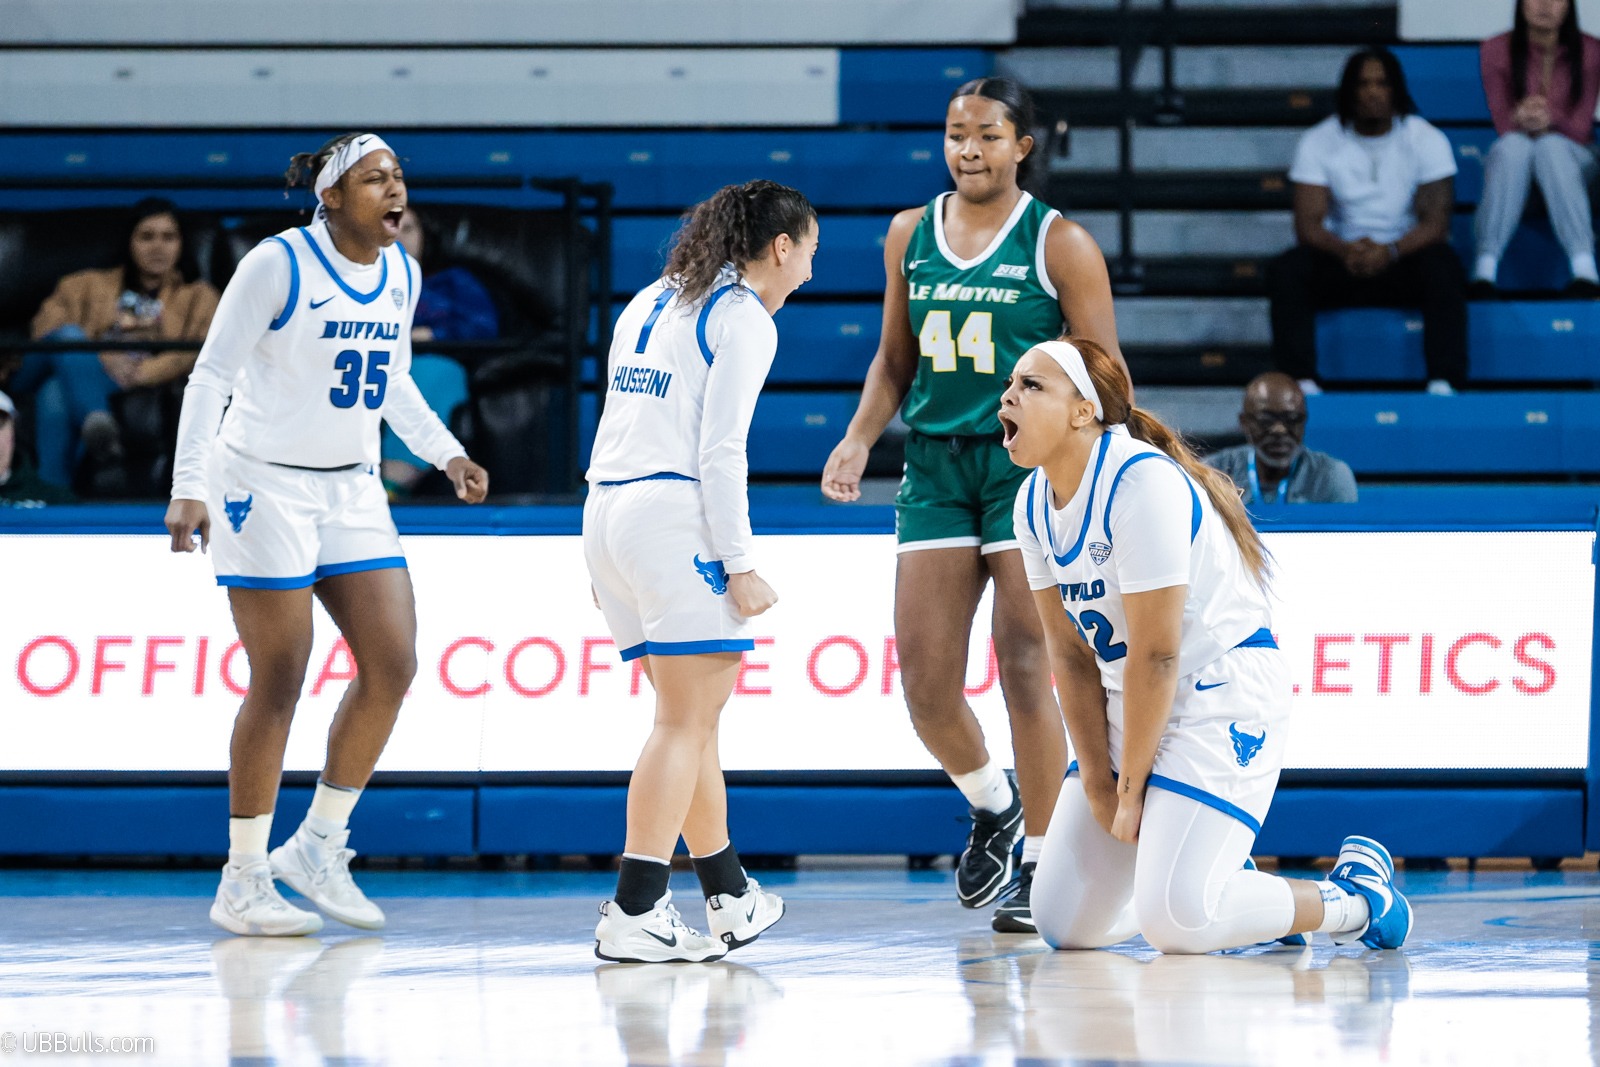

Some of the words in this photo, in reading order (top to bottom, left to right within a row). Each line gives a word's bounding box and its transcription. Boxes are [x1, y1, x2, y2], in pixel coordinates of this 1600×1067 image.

[635, 288, 678, 354] 1
[909, 282, 932, 300] LE
[931, 283, 1021, 304] MOYNE
[318, 320, 399, 340] BUFFALO
[918, 310, 996, 374] 44
[329, 350, 390, 410] 35
